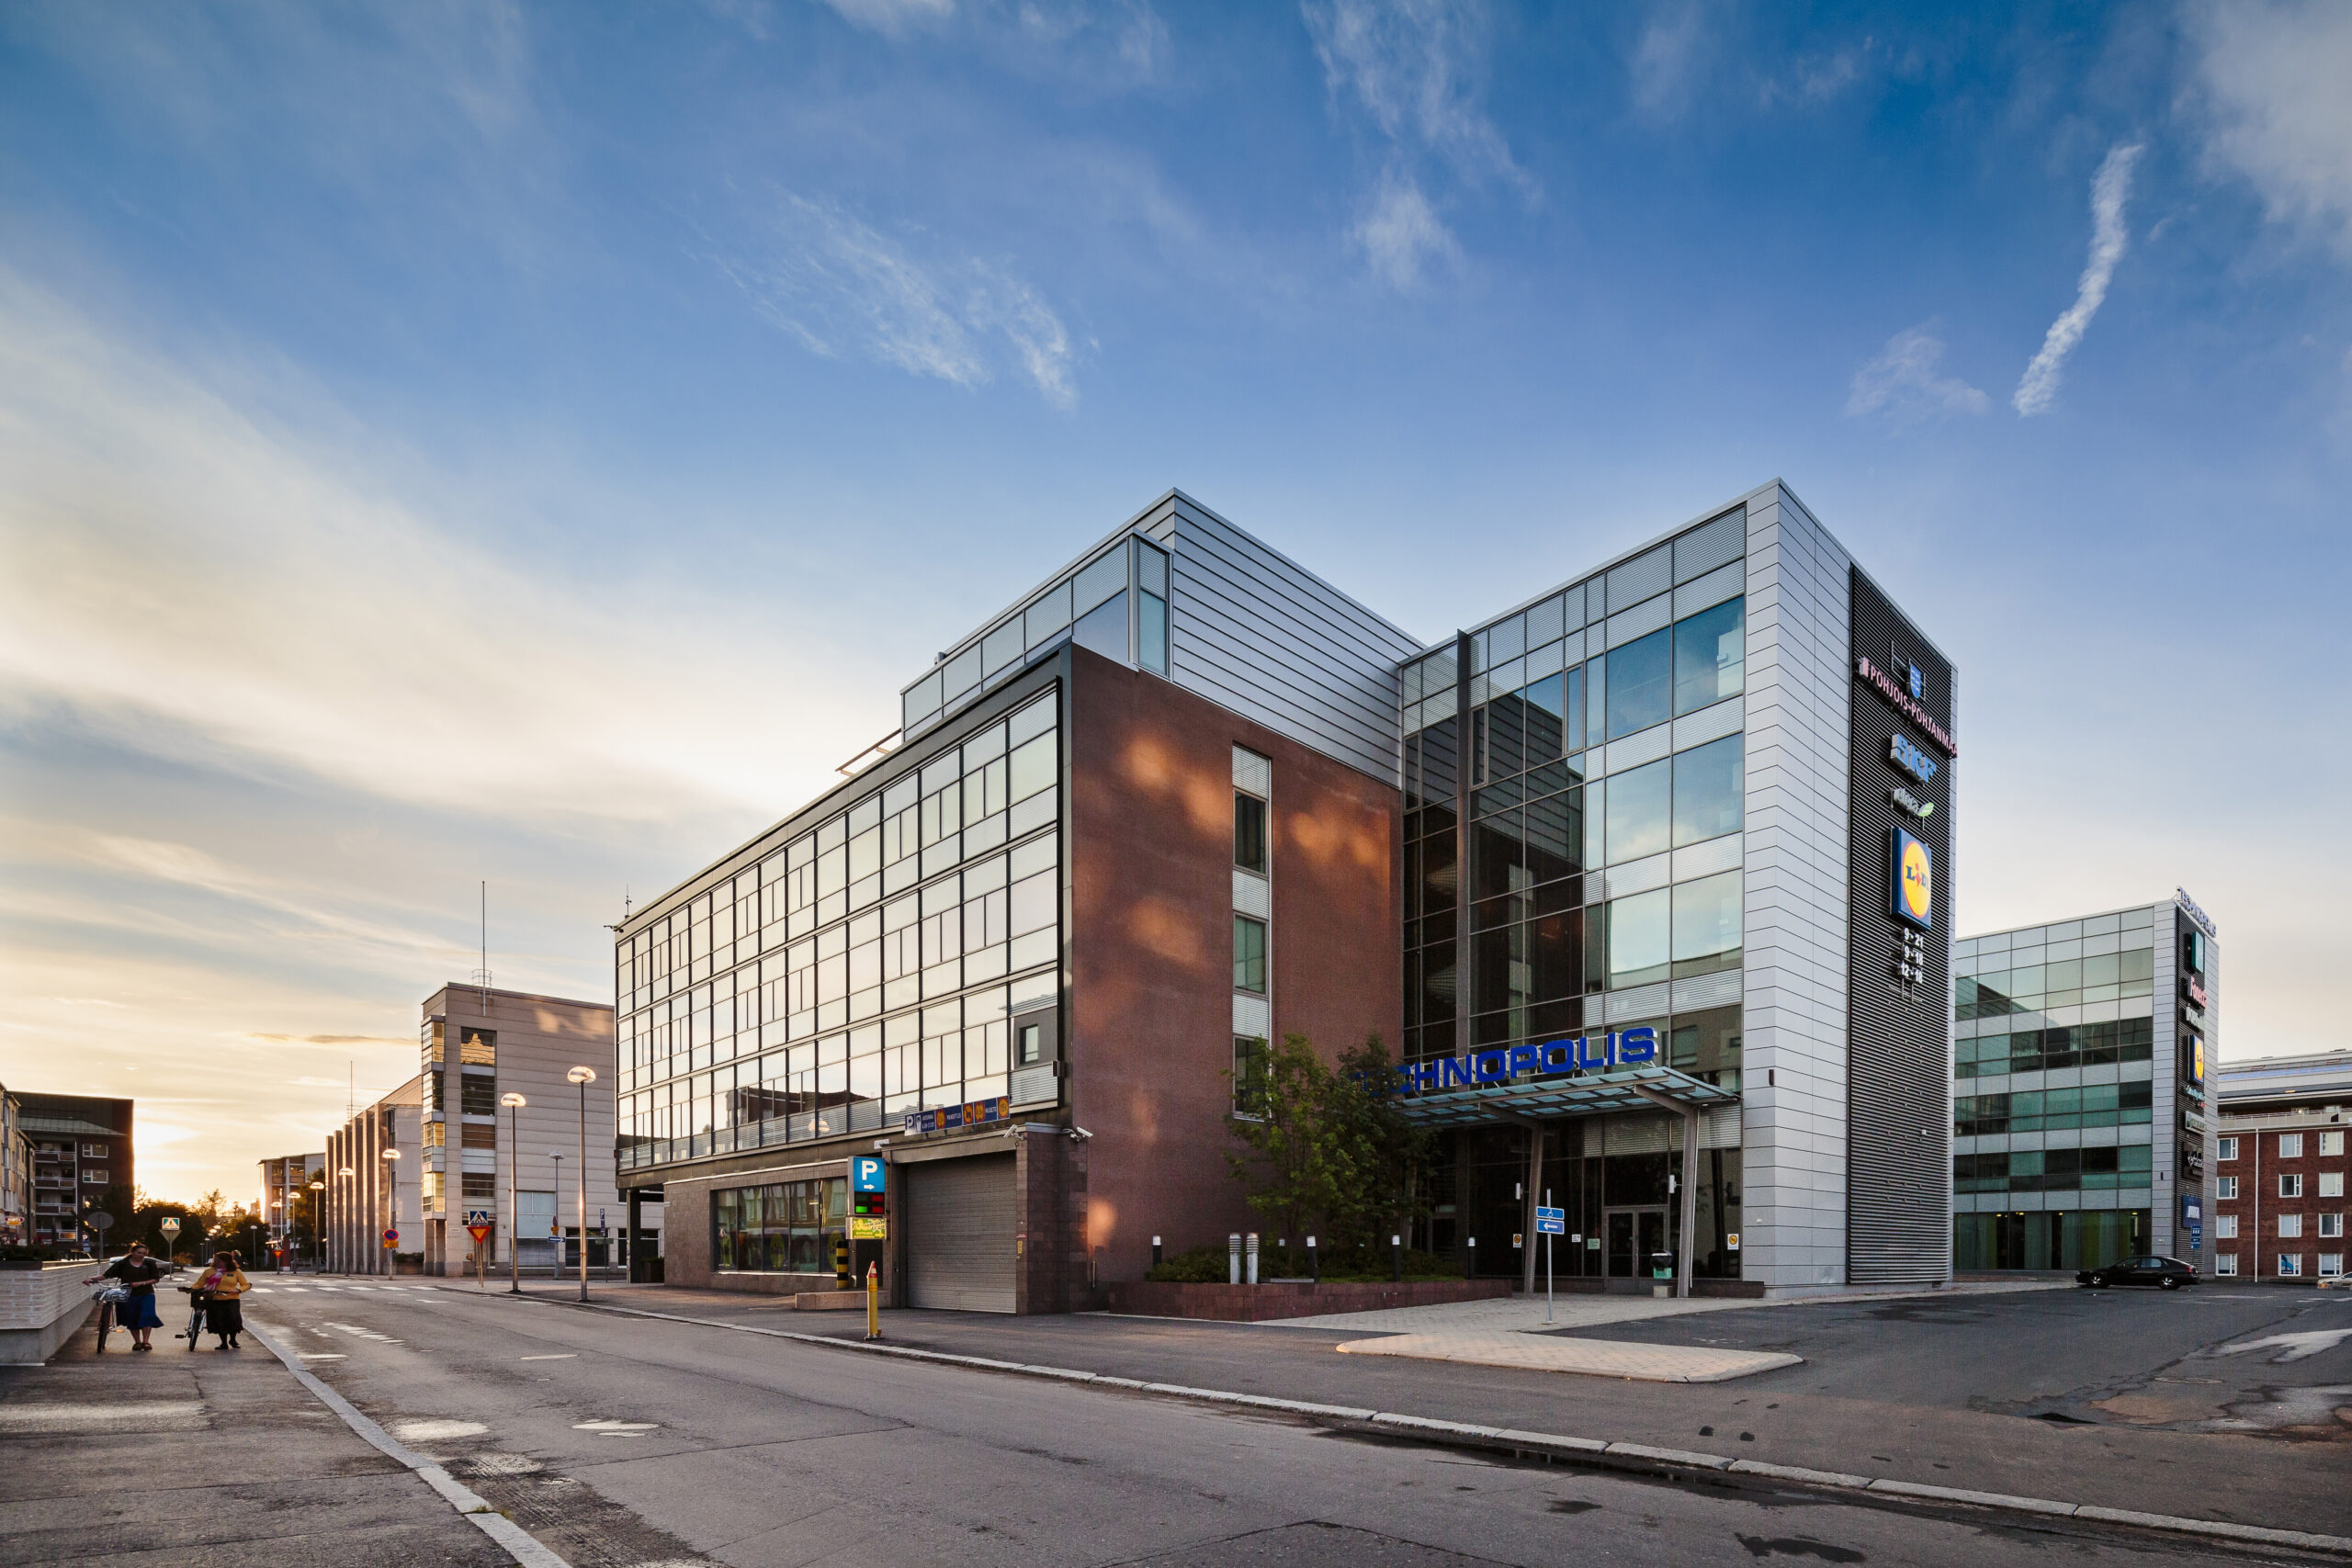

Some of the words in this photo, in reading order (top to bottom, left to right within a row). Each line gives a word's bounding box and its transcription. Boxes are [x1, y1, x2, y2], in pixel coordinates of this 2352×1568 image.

[1871, 665, 1958, 756] POHJOIS-POHJANMAA
[1895, 734, 1938, 784] SKF
[862, 1160, 878, 1181] P
